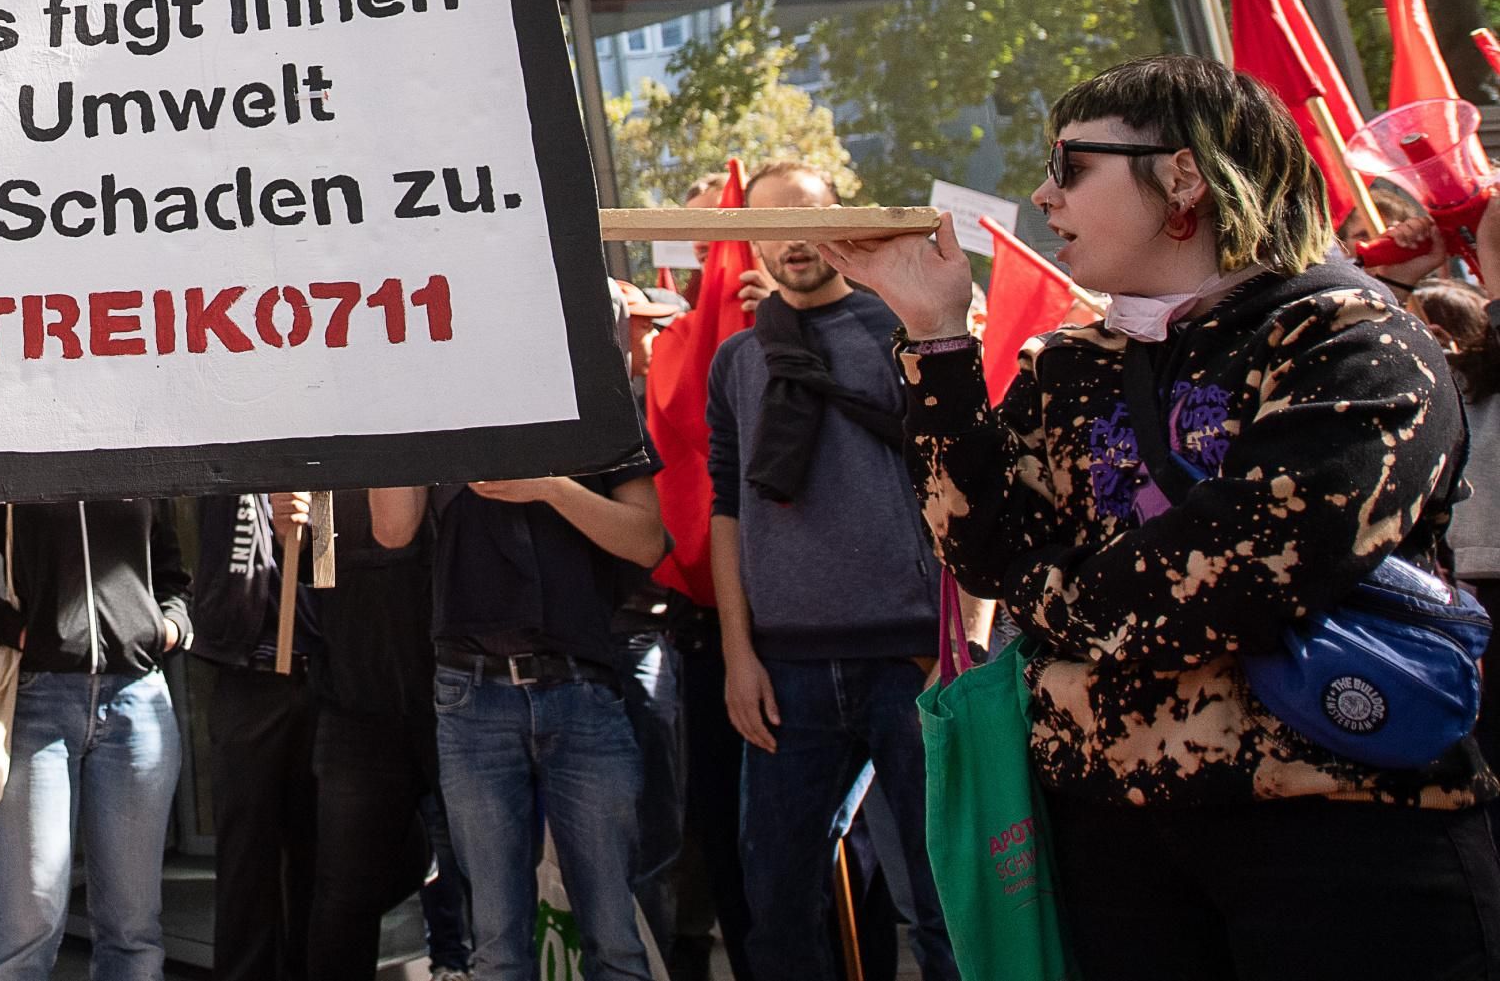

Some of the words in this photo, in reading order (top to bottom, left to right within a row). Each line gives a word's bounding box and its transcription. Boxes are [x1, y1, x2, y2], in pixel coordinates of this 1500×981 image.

[19, 63, 335, 143] Umwelt
[393, 165, 523, 218] zu.
[1331, 677, 1353, 691] THE
[1354, 678, 1385, 720] BULLDOG
[1325, 695, 1373, 731] AMSTERDAM
